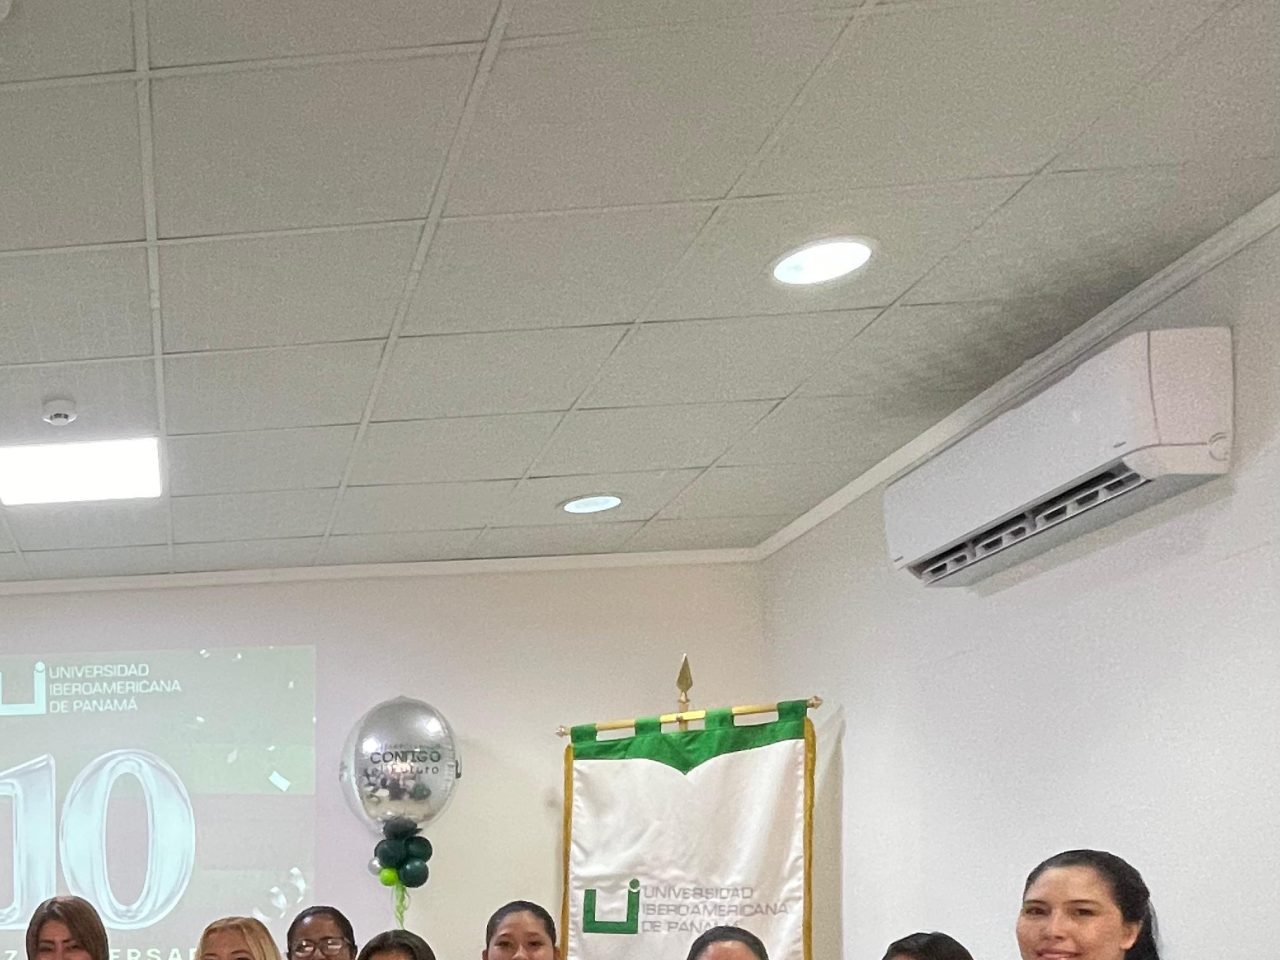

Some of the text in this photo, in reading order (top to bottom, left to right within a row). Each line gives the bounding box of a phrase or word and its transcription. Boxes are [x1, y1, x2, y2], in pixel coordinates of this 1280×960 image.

[49, 663, 150, 679] UNIVERSIDAD
[49, 679, 182, 696] IBEROAMERICANA
[50, 697, 138, 713] DE PANAMÁ
[370, 751, 441, 764] CONTIGO
[643, 886, 753, 899] UNIVERSIDAD
[642, 902, 789, 917] IBEROAMERICANA
[642, 920, 662, 932] DE
